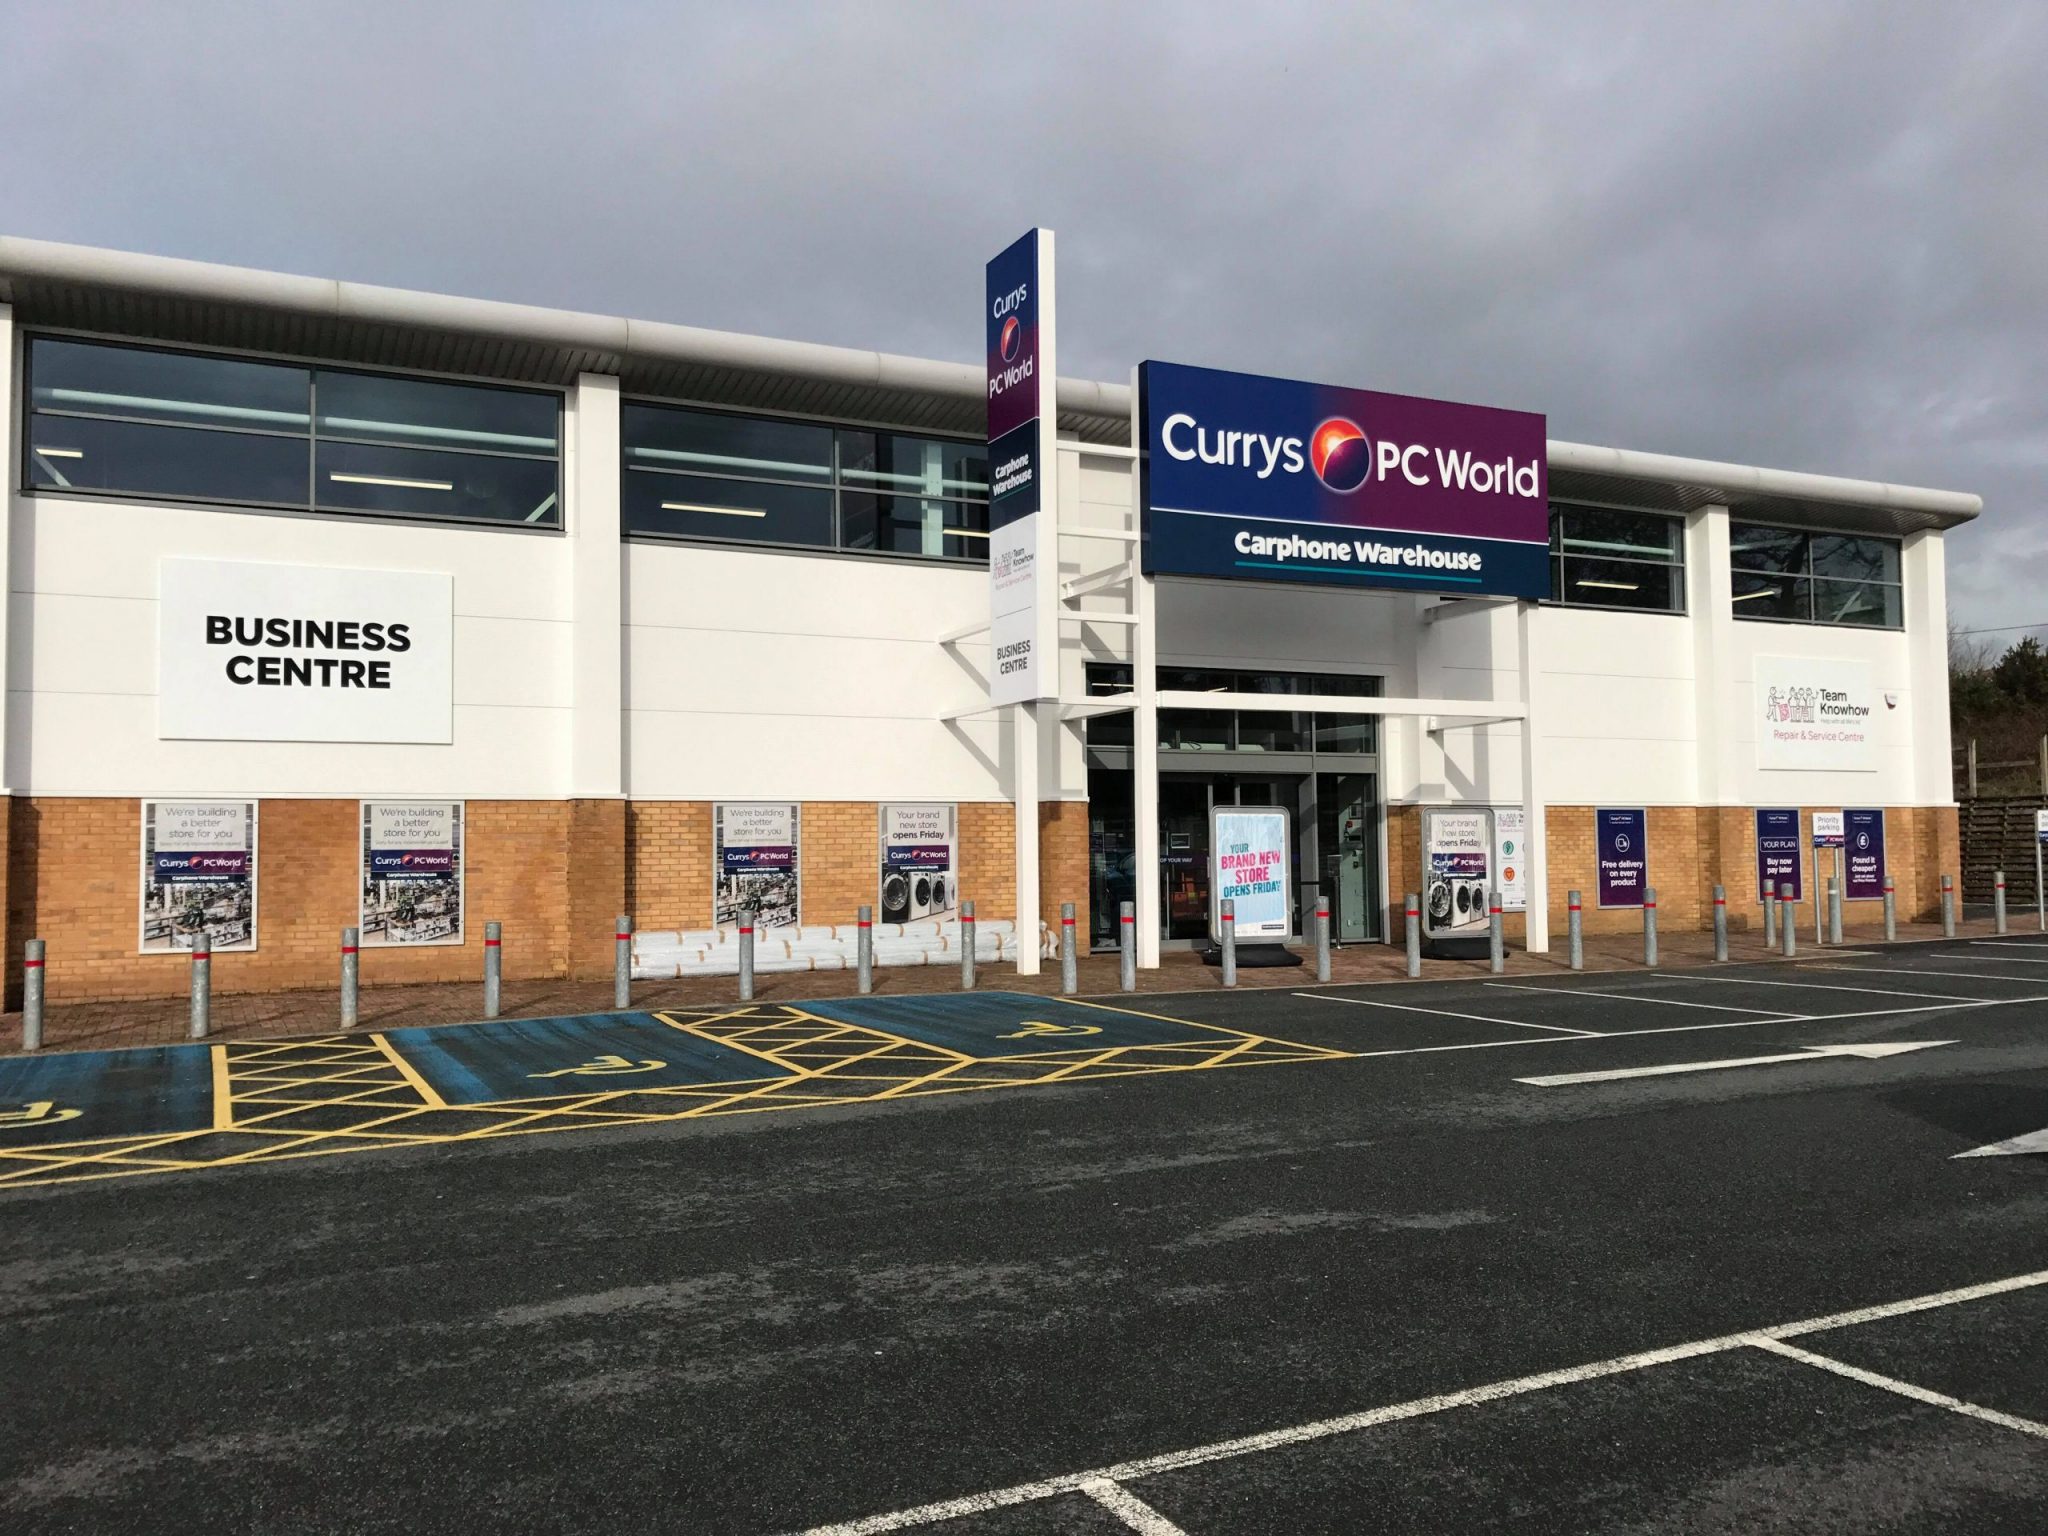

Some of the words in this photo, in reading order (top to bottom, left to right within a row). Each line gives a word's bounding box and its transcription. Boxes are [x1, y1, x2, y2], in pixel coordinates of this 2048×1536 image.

[994, 284, 1027, 318] Currys
[990, 374, 1004, 399] PC
[1004, 354, 1032, 390] World
[1162, 413, 1304, 480] Currys
[1377, 441, 1430, 486] PC
[1435, 448, 1539, 498] World
[995, 454, 1029, 479] Carphone
[993, 469, 1032, 496] Warehouse
[1234, 531, 1351, 564] Carphone
[1354, 541, 1482, 571] Warehouse
[206, 616, 411, 652] BUSINESS
[997, 640, 1031, 660] BUSINESS
[1000, 657, 1028, 675] CENTRE
[226, 655, 391, 689] CENTRE
[1820, 689, 1847, 702] Team
[1820, 703, 1869, 716] Knowhow
[1774, 729, 1798, 741] Repair
[1800, 730, 1806, 740] &
[1808, 730, 1836, 741] Service
[1838, 732, 1864, 742] Centre
[165, 808, 195, 816] We're
[197, 808, 237, 818] building
[380, 808, 406, 816] We're
[408, 808, 444, 818] building
[897, 811, 914, 819] Your
[917, 811, 940, 819] brand
[190, 819, 221, 827] better
[1817, 816, 1838, 824] Priority
[168, 830, 194, 838] store
[197, 829, 211, 838] for
[214, 831, 232, 840] you
[408, 829, 421, 837] for
[892, 832, 918, 840] opens
[920, 831, 944, 839] Friday
[1230, 843, 1249, 854] YOUR
[1460, 839, 1481, 847] Friday
[160, 859, 189, 868] Currys
[204, 859, 216, 867] PC
[216, 858, 241, 867] World
[375, 857, 401, 866] Currys
[1221, 853, 1256, 869] BRAND
[1259, 850, 1280, 865] NEW
[1602, 860, 1617, 868] Free
[1618, 860, 1643, 869] delivery
[1767, 858, 1778, 866] Buy
[1853, 856, 1870, 864] Found
[1236, 866, 1270, 884] STORE
[1620, 870, 1637, 878] every
[1767, 867, 1778, 875] pay
[1611, 878, 1636, 888] product
[1224, 884, 1251, 898] OPENS
[1253, 880, 1280, 894] FRIDAY
